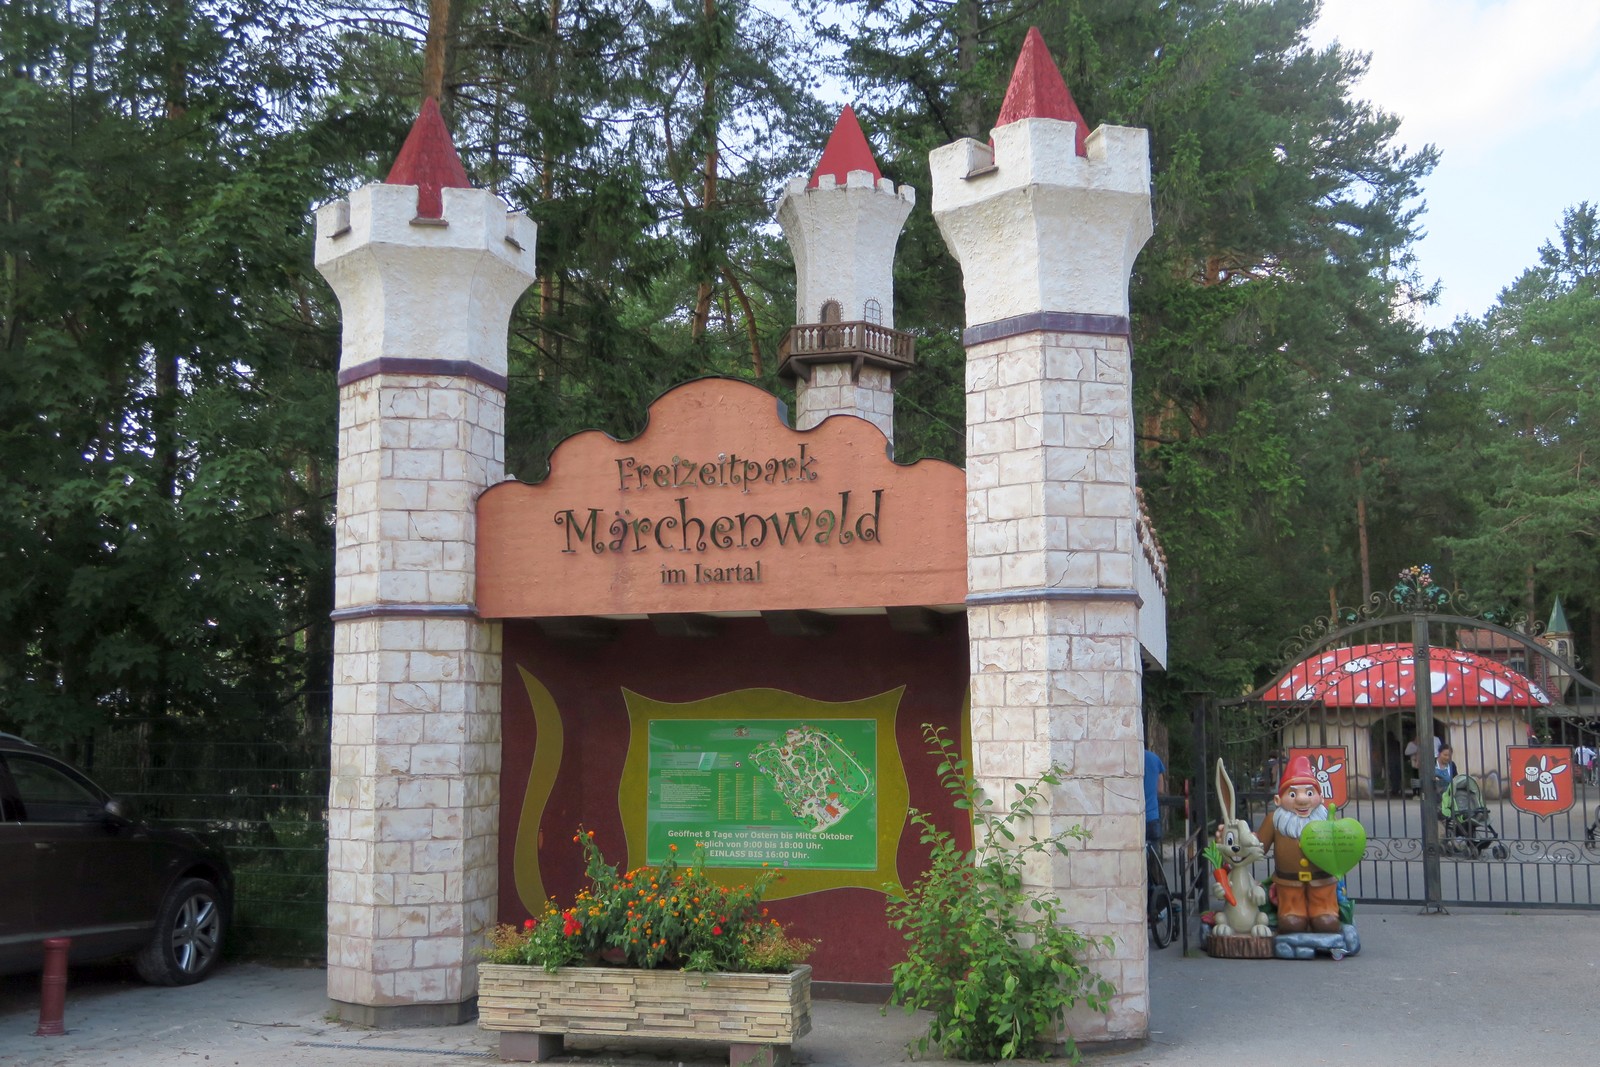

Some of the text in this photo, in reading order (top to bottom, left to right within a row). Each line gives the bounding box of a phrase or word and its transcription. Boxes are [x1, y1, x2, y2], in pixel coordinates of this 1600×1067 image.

[615, 443, 818, 494] Freizeitpark
[554, 489, 884, 555] Märchenwald
[660, 561, 763, 585] im Isartal
[667, 830, 703, 838] Geöffnet
[713, 831, 733, 840] Tage
[750, 831, 779, 839] Ostern
[795, 832, 817, 840] Mitte
[819, 832, 854, 840] Oktober
[805, 842, 824, 850] Uhr.
